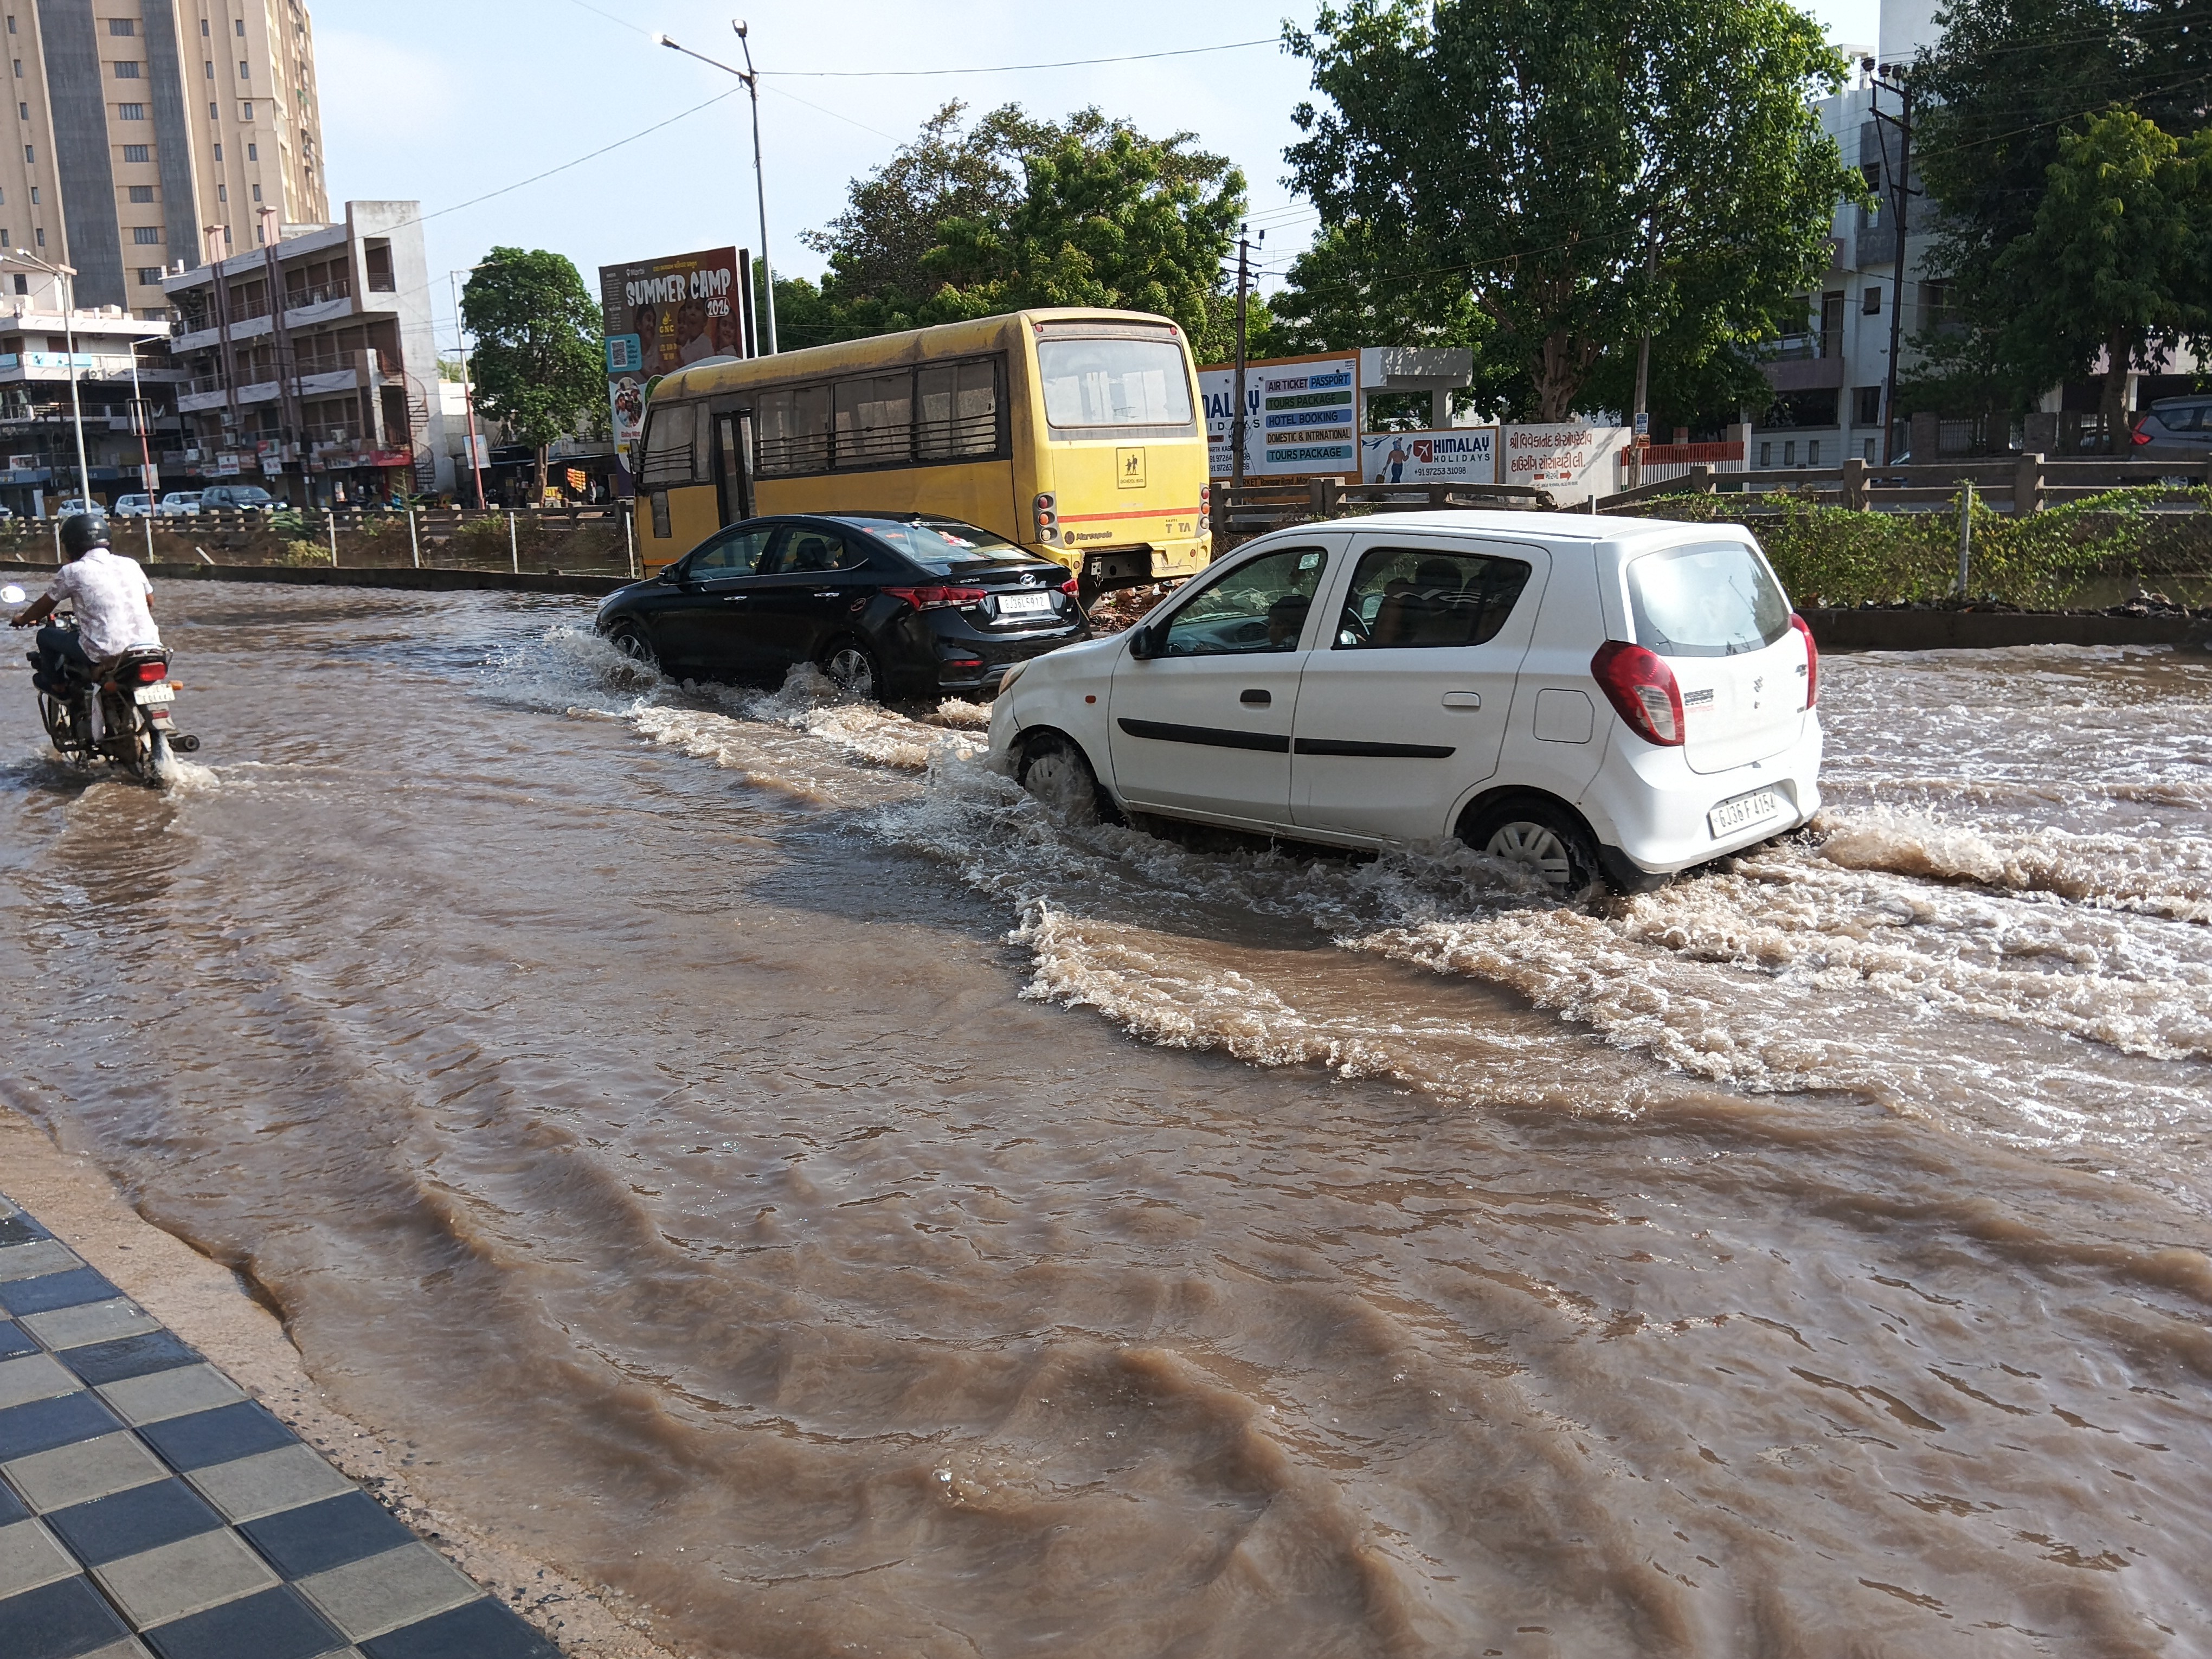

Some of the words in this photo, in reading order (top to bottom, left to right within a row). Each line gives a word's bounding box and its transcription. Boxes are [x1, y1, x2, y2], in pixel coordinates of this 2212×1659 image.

[626, 275, 686, 306] SUMMER
[690, 268, 730, 299] CAMP
[707, 299, 729, 315] 2026
[659, 325, 674, 333] GNC
[1268, 381, 1281, 391] AIR
[1282, 378, 1308, 390] TICKET
[1311, 374, 1349, 388] PASSPORT
[1268, 398, 1295, 408] TOURS
[1297, 394, 1336, 407] PACKAGE
[1269, 415, 1296, 426] HOTEL
[1299, 411, 1338, 424] BOOKING
[1268, 433, 1297, 443] DOMESTIC
[1298, 432, 1304, 441] &
[1306, 429, 1350, 441] INTRNATIONAL
[1509, 432, 1519, 449] શ્રી
[1433, 437, 1489, 453] HIMALAY
[1270, 450, 1298, 460] TOURS
[1300, 447, 1341, 459] PACKAGE
[1434, 453, 1490, 462] HOLIDAYS
